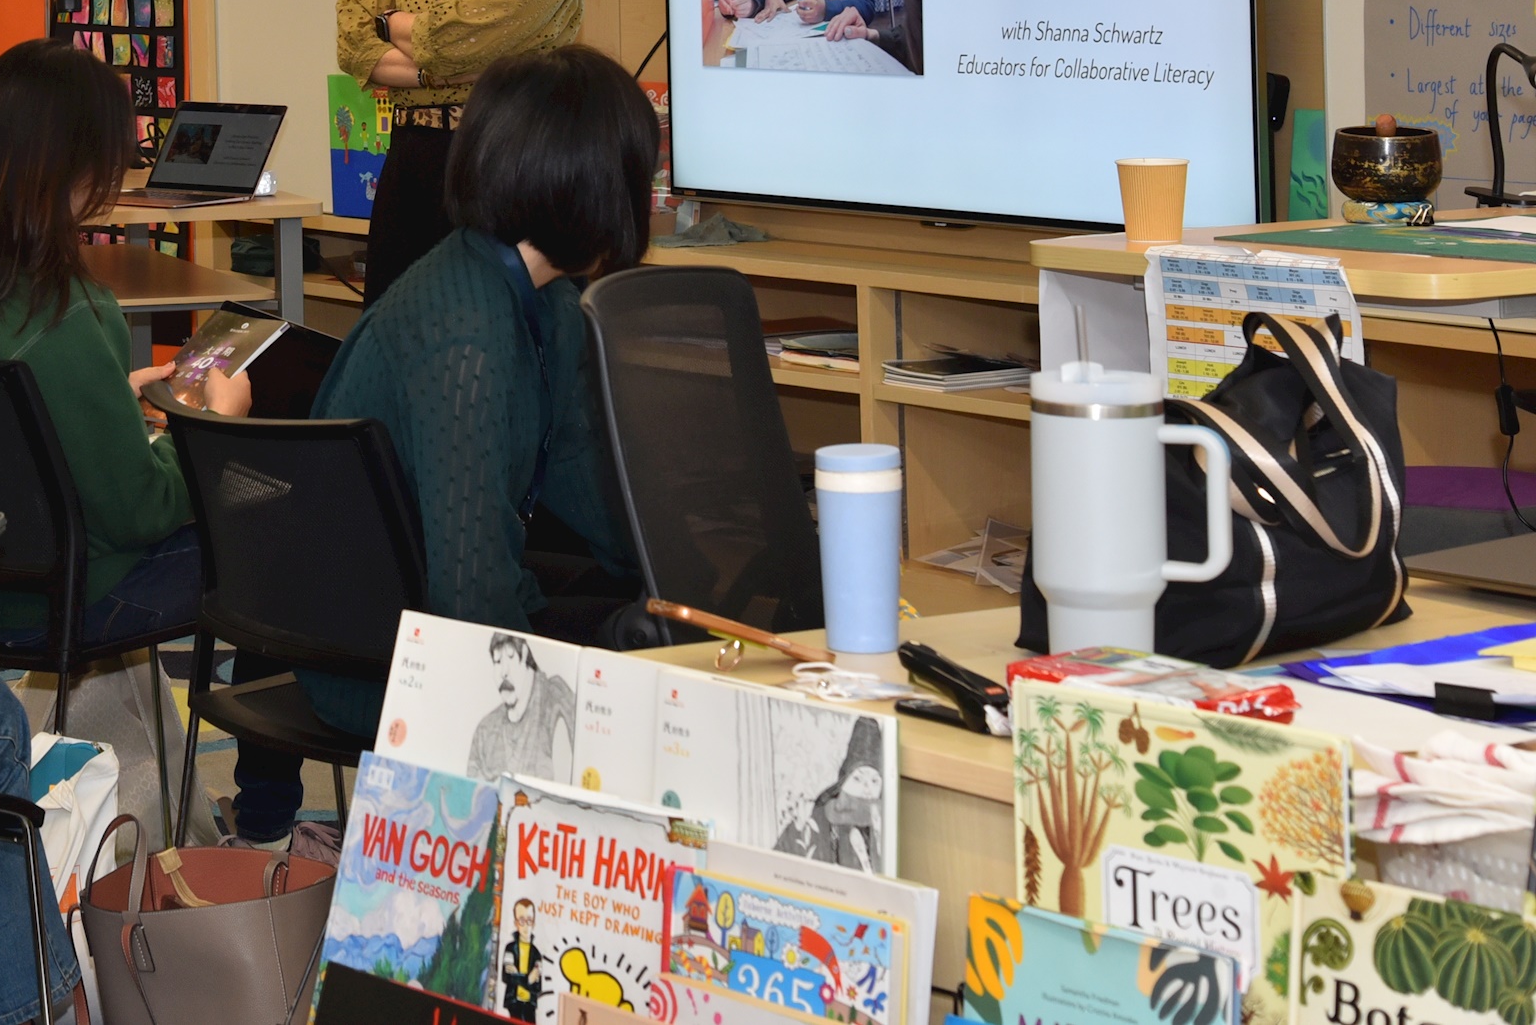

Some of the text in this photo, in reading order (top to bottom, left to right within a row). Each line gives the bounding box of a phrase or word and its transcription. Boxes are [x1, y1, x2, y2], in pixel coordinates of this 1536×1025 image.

[1002, 20, 1163, 45] with Shanna Schwartz
[1409, 6, 1471, 46] Different
[957, 55, 1214, 90] Educators for Collaborative Literacy
[363, 814, 491, 893] VAN GOGH
[518, 822, 585, 879] KEITH
[376, 869, 460, 904] and the seasons
[556, 884, 640, 920] THE BOY WHO
[1114, 866, 1241, 942] Trees
[538, 901, 663, 945] JUST KEPT DRAWING
